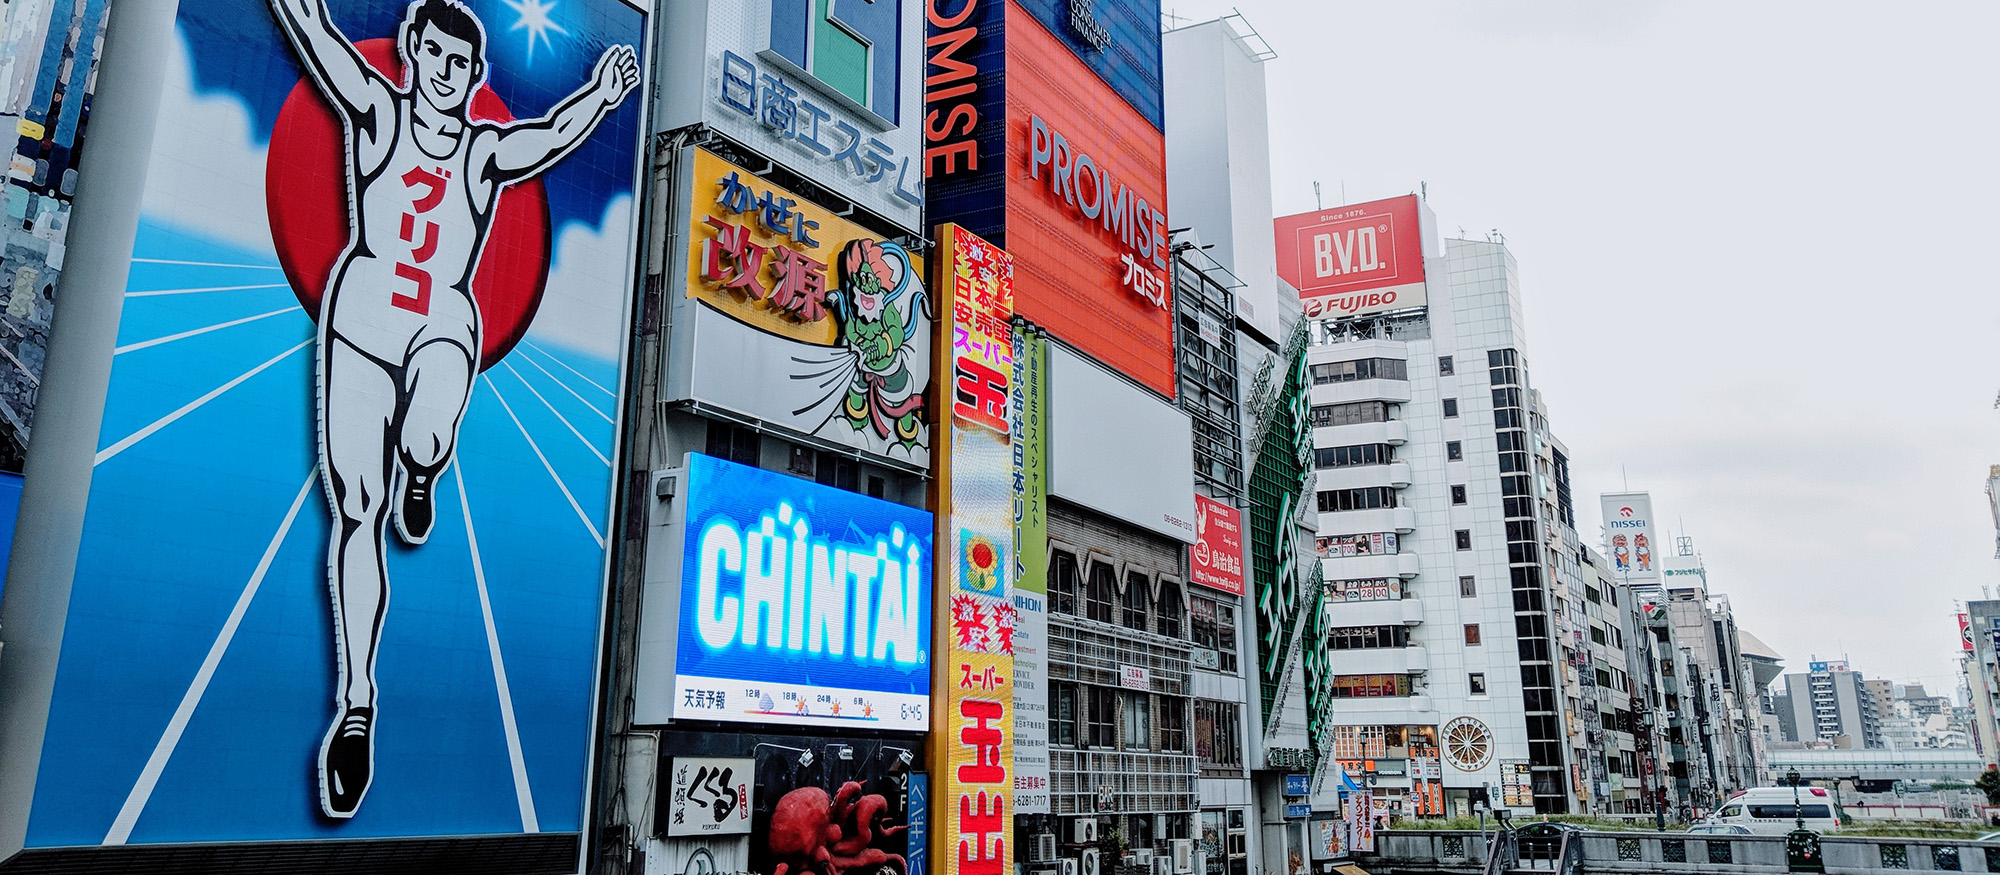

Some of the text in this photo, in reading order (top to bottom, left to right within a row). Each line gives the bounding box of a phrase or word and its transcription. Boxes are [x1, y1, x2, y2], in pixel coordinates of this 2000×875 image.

[1071, 0, 1112, 48] CONSUMER
[1072, 12, 1104, 54] FINANCE
[719, 50, 924, 206] 日商エステム
[1029, 114, 1167, 271] PROMISE
[716, 171, 820, 248] かぜに
[1320, 208, 1367, 222] Since 1876.
[391, 165, 453, 316] グリコ
[1314, 226, 1386, 278] B.V.D.
[701, 215, 828, 321] 改源
[955, 275, 1012, 315] 日本一
[1121, 253, 1167, 311] プロミス
[1326, 291, 1397, 313] FUJIBO
[955, 327, 1013, 365] スーパー
[1611, 520, 1646, 528] NISSEI
[698, 502, 920, 663] CHINTAI
[1013, 595, 1041, 613] NIHON
[1013, 646, 1037, 655] nvestment
[960, 664, 1004, 691] スーパー
[1013, 669, 1031, 679] ERVICE
[1013, 680, 1035, 690] ROVIDER
[684, 689, 726, 710] 天気予報
[745, 689, 760, 699] 12時
[782, 692, 797, 701] 18時
[817, 695, 831, 704] 24時
[854, 697, 864, 706] 6時
[686, 766, 739, 822] くくる
[1014, 775, 1046, 790] 告主募集中
